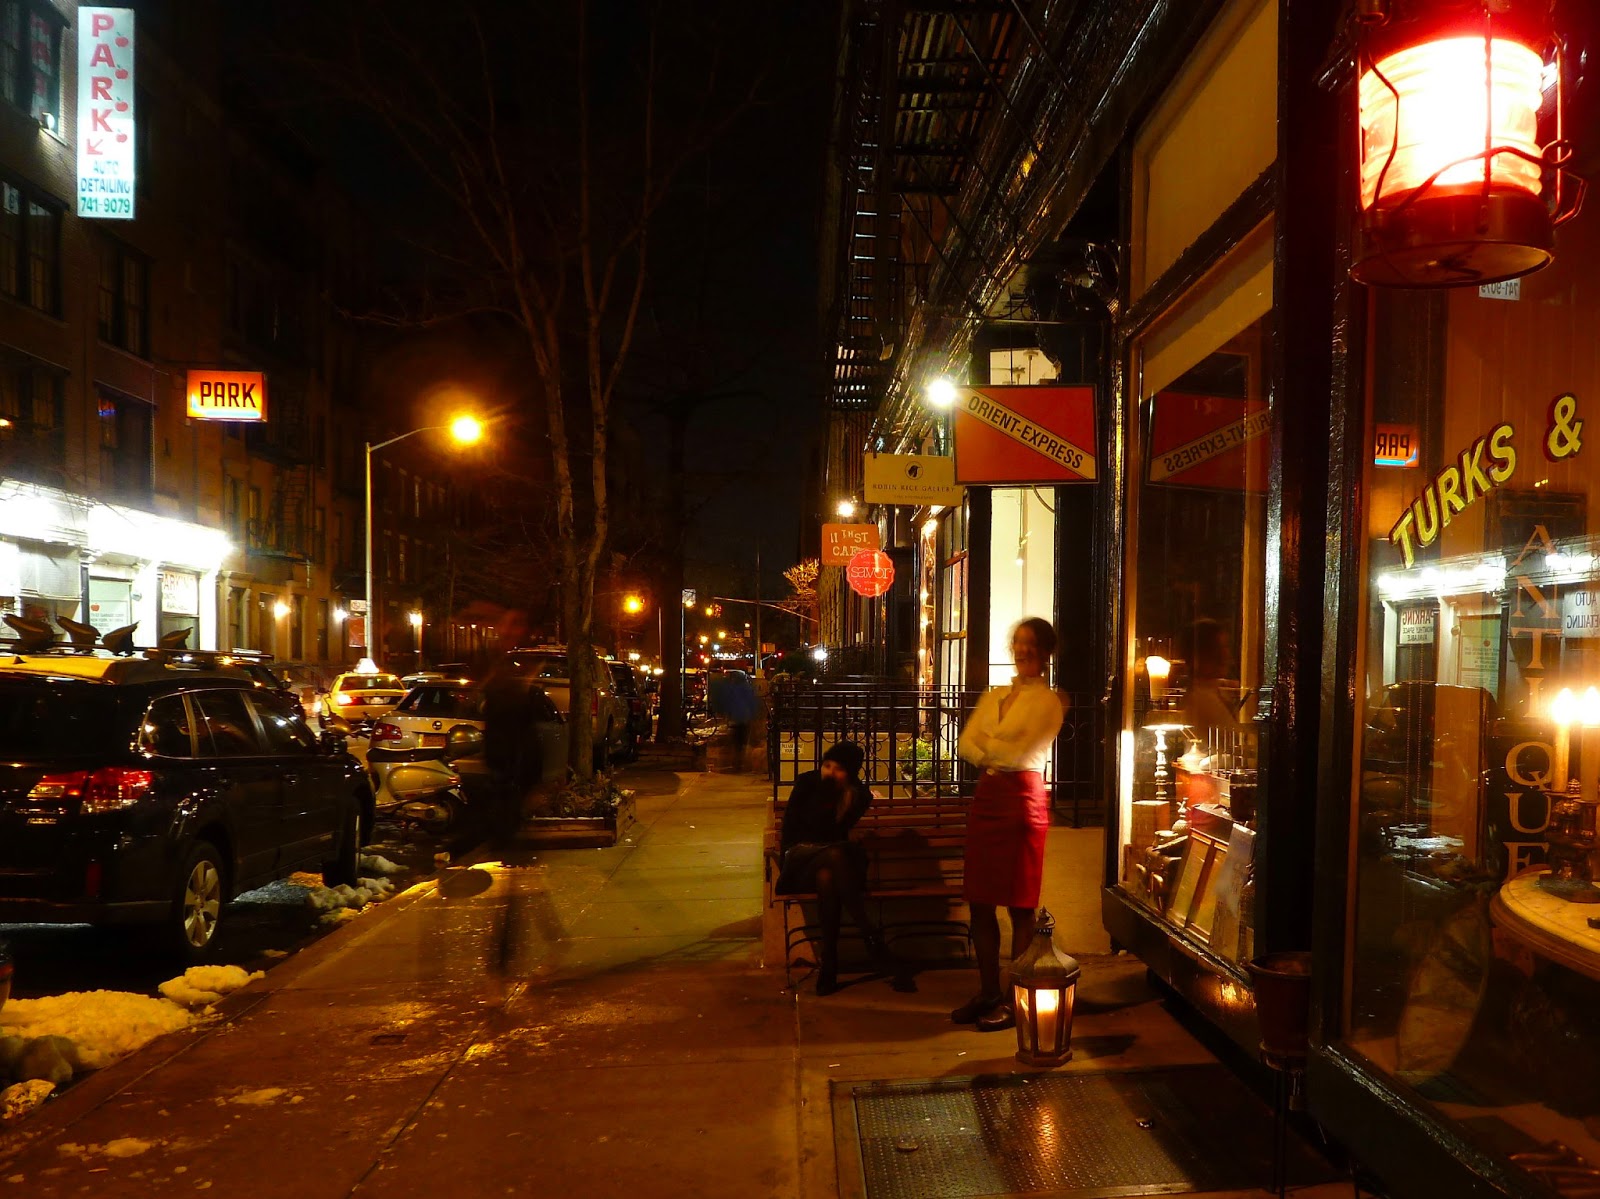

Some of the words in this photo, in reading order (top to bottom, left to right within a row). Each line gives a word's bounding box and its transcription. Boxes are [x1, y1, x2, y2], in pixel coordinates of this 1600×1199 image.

[90, 13, 116, 133] PARK
[80, 178, 131, 194] DETAILING
[80, 196, 130, 213] 741-9079
[200, 381, 257, 409] PARK
[968, 395, 1083, 469] ORIENT-EXPRESS
[901, 484, 918, 492] RICE
[922, 485, 955, 493] GALLERY
[1390, 423, 1517, 569] TURKS
[1546, 393, 1584, 460] &
[832, 545, 862, 557] CAF
[850, 566, 892, 579] savor
